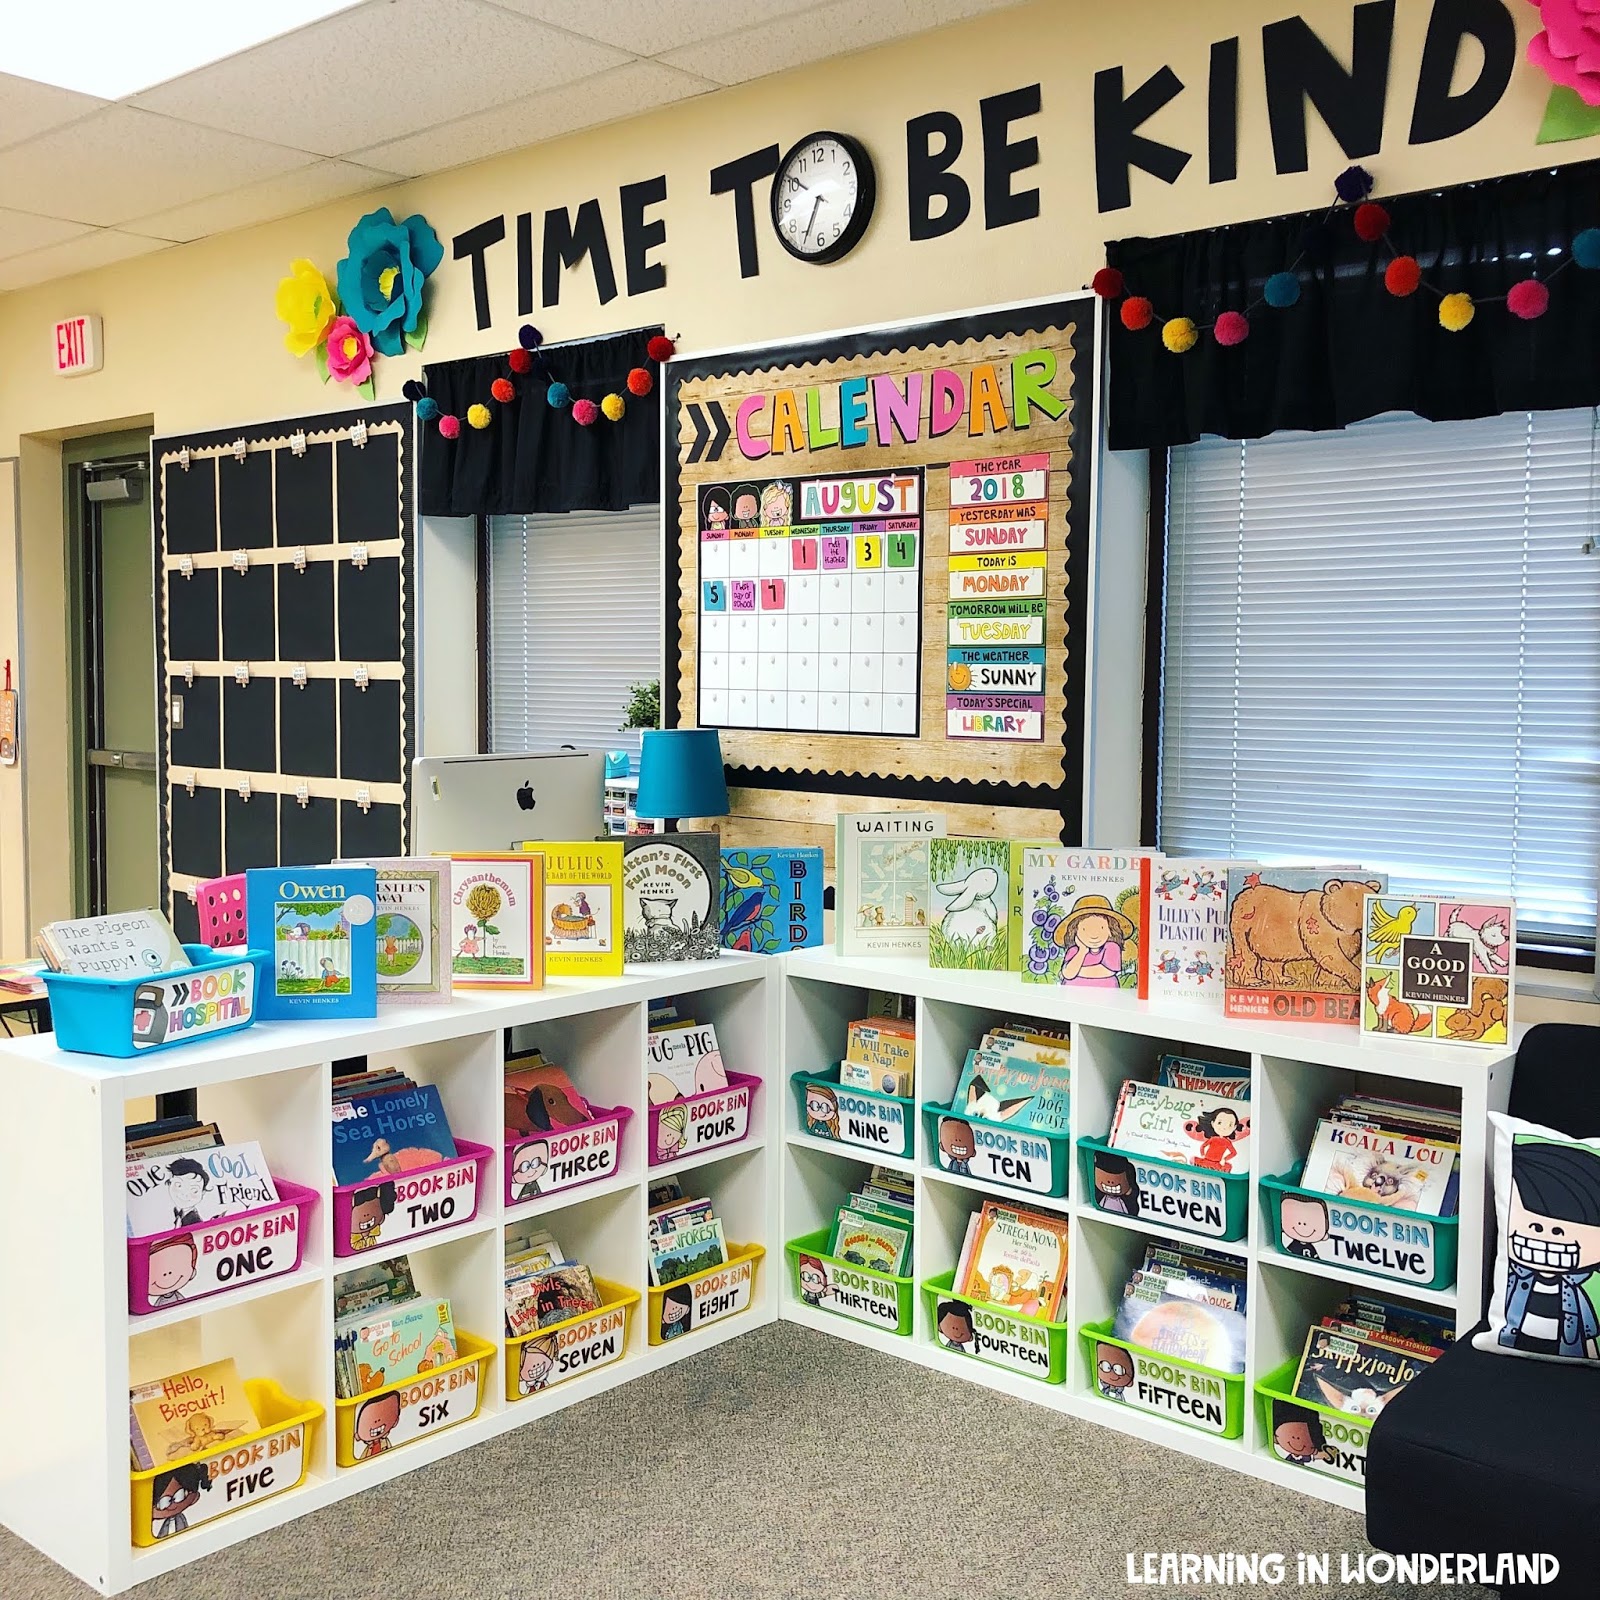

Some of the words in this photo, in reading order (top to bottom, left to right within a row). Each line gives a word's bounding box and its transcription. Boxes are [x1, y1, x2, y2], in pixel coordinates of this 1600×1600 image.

[452, 175, 667, 330] TIME
[906, 83, 1041, 241] BE
[1094, 0, 1516, 213] KIND
[57, 319, 84, 368] EXIT
[735, 348, 1068, 460] CALENDAR
[975, 462, 993, 472] THE
[996, 459, 1021, 470] YEAR
[805, 478, 914, 516] AUGUST
[969, 474, 1024, 501] 2018
[961, 509, 1014, 521] YESTERDAY
[1016, 506, 1036, 517] WAS
[823, 524, 850, 533] THURSDAY
[965, 527, 1028, 546] SUNDAY
[802, 545, 806, 564] 1
[977, 558, 1005, 567] TODAY
[963, 575, 1029, 592] MONDAY
[950, 604, 1006, 615] TOMORROW
[1008, 604, 1029, 614] WILL
[1032, 603, 1043, 613] BE
[960, 622, 1031, 640] TUESDAY
[962, 652, 980, 661] THE
[982, 651, 1029, 661] WEATHER
[981, 669, 1036, 685] SUNNY
[957, 698, 992, 708] TODAY'S
[996, 698, 1032, 708] SPECIAL
[962, 715, 1026, 733] LIBRARY
[856, 821, 934, 833] WAITING
[547, 856, 603, 870] JULIUS
[674, 853, 703, 879] First
[1029, 854, 1058, 868] MY
[279, 880, 346, 899] Owen
[452, 873, 516, 907] Chrysanthemum
[625, 867, 651, 890] Full
[655, 865, 691, 889] Moon
[1159, 905, 1201, 924] LILLY'S
[58, 925, 90, 940] The
[96, 917, 150, 936] Pigeon
[1160, 924, 1207, 942] PLASTIC
[68, 940, 120, 956] Wants
[126, 939, 136, 948] a
[1430, 943, 1442, 955] A
[78, 955, 138, 973] Puppy!
[1407, 956, 1465, 973] GOOD
[189, 968, 246, 1004] BOOK
[1417, 973, 1455, 988] DAY
[1230, 994, 1269, 1005] KEVIN
[1273, 994, 1316, 1017] OLD
[1230, 1005, 1269, 1014] HENKES
[1433, 993, 1465, 1002] HENKES
[169, 996, 250, 1033] HOSPITAL
[684, 1032, 713, 1057] PIG
[859, 1039, 880, 1052] Will
[884, 1043, 909, 1058] Take
[872, 1053, 896, 1068] Nap!
[1175, 1074, 1244, 1098] THIDWICK
[372, 1091, 429, 1115] Lonely
[690, 1099, 725, 1122] BOOK
[727, 1092, 747, 1112] BIN
[838, 1096, 876, 1118] BOOK
[879, 1105, 903, 1125] BIN
[1037, 1096, 1067, 1114] DOG-
[334, 1124, 374, 1144] Sea
[378, 1111, 437, 1134] Horse
[697, 1116, 736, 1143] FOUR
[849, 1118, 890, 1144] NINE
[1029, 1111, 1069, 1130] HOUSE
[550, 1133, 590, 1158] BOOK
[593, 1125, 616, 1146] BIN
[975, 1129, 1018, 1154] BOOK
[1021, 1141, 1048, 1162] BIN
[1330, 1128, 1395, 1155] KOALA
[1404, 1145, 1444, 1165] LOU
[550, 1149, 610, 1182] THREE
[988, 1153, 1032, 1182] TEN
[397, 1175, 443, 1203] BOOK
[448, 1165, 474, 1189] BIN
[1137, 1167, 1186, 1194] BOOK
[1190, 1179, 1222, 1203] BIN
[407, 1197, 455, 1228] TWO
[1139, 1190, 1222, 1227] ELEVEN
[202, 1223, 259, 1255] BOOK
[263, 1212, 296, 1239] BIN
[997, 1222, 1029, 1240] STREGA
[1031, 1231, 1057, 1248] NONA
[1330, 1209, 1388, 1237] BOOK
[1392, 1221, 1430, 1248] BIN
[216, 1246, 274, 1282] ONE
[1328, 1235, 1426, 1275] TWELVE
[694, 1274, 728, 1299] BOOK
[731, 1264, 750, 1285] BIN
[832, 1268, 869, 1292] BOOK
[872, 1277, 896, 1301] BIN
[510, 1304, 537, 1328] Live
[540, 1300, 554, 1312] in
[557, 1296, 593, 1310] Trees
[699, 1289, 739, 1319] EIGHT
[832, 1288, 898, 1321] THIRTEEN
[558, 1321, 598, 1349] BOOK
[600, 1311, 623, 1334] BIN
[974, 1311, 1016, 1337] BOOK
[1019, 1325, 1047, 1348] BIN
[373, 1340, 389, 1357] Go
[390, 1330, 400, 1345] to
[389, 1332, 422, 1366] School
[559, 1336, 615, 1373] SEVEN
[974, 1332, 1049, 1368] FOURTEEN
[163, 1375, 209, 1400] Hello,
[400, 1378, 445, 1409] BOOK
[449, 1366, 476, 1390] BIN
[1138, 1359, 1187, 1388] BOOK
[1190, 1375, 1221, 1401] BIN
[159, 1386, 225, 1423] Biscuit!
[418, 1400, 449, 1427] SIX
[1138, 1381, 1222, 1426] FIFTEEN
[208, 1444, 265, 1481] BOOK
[267, 1429, 301, 1460] BIN
[226, 1466, 275, 1502] FIVE
